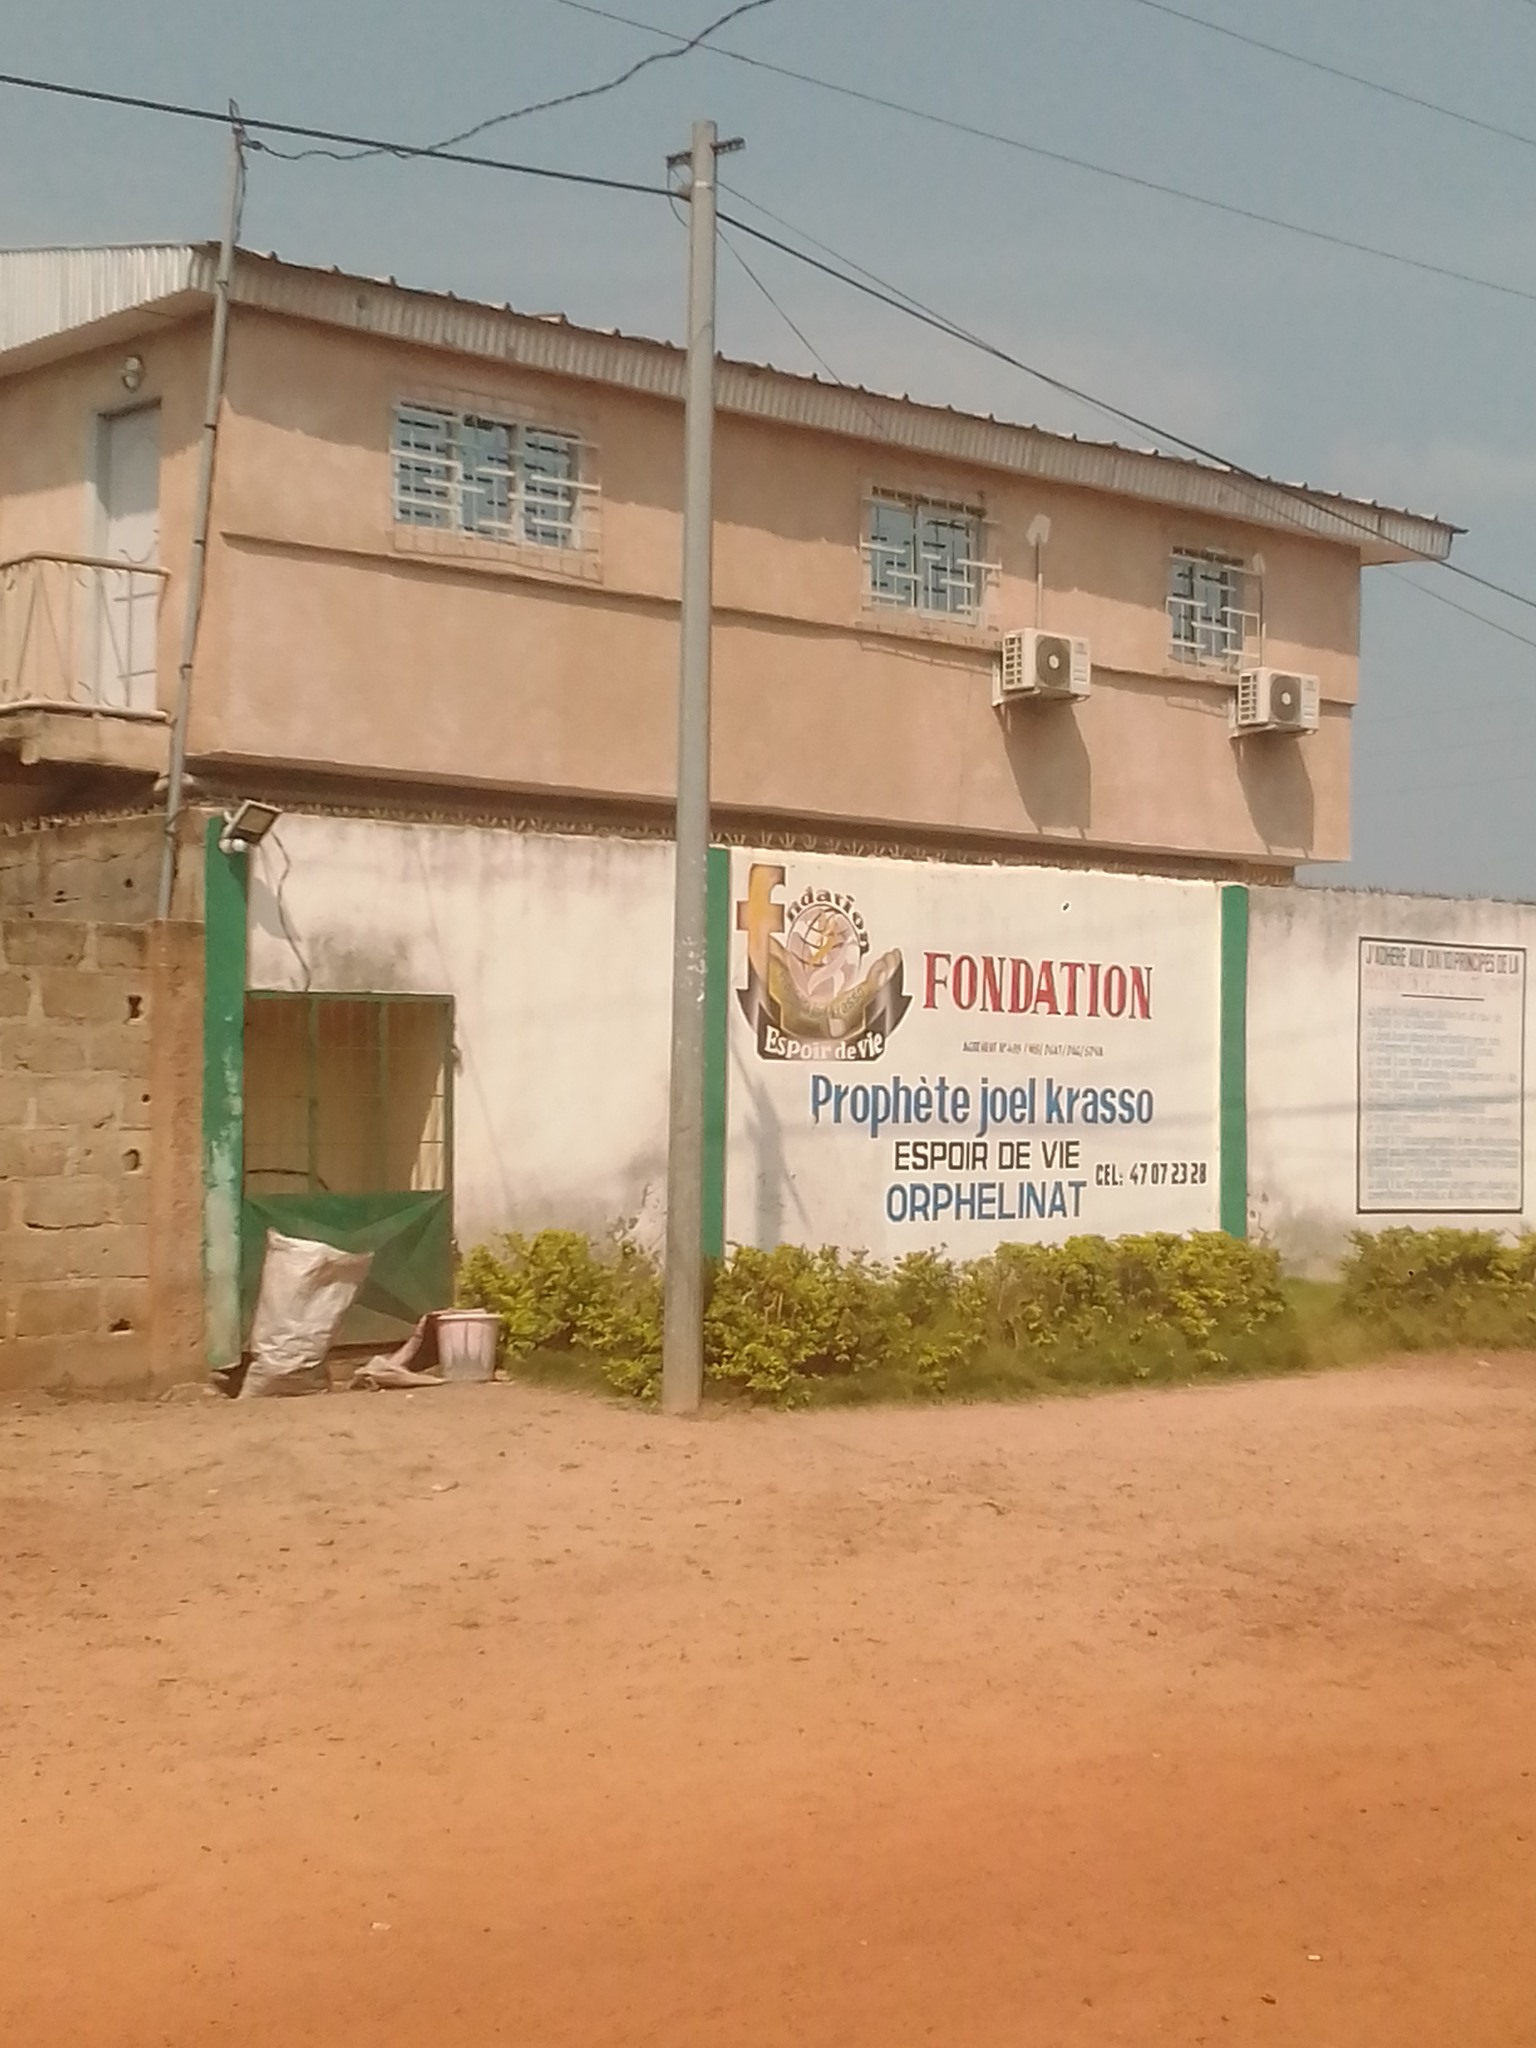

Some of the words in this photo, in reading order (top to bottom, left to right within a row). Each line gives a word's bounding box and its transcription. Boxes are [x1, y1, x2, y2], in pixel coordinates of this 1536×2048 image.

[923, 951, 1153, 1019] FONDATION
[764, 1025, 831, 1060] Espoir
[835, 1041, 857, 1060] de
[811, 1074, 970, 1139] Prophète
[977, 1077, 1036, 1138] joel
[1045, 1079, 1154, 1124] krasso
[895, 1141, 988, 1170] ESPOIR
[998, 1141, 1032, 1169] DE
[1041, 1141, 1081, 1169] VIE
[1095, 1163, 1123, 1186] CEL:
[1129, 1162, 1148, 1186] 47
[887, 1180, 1088, 1222] ORPHELINAT
